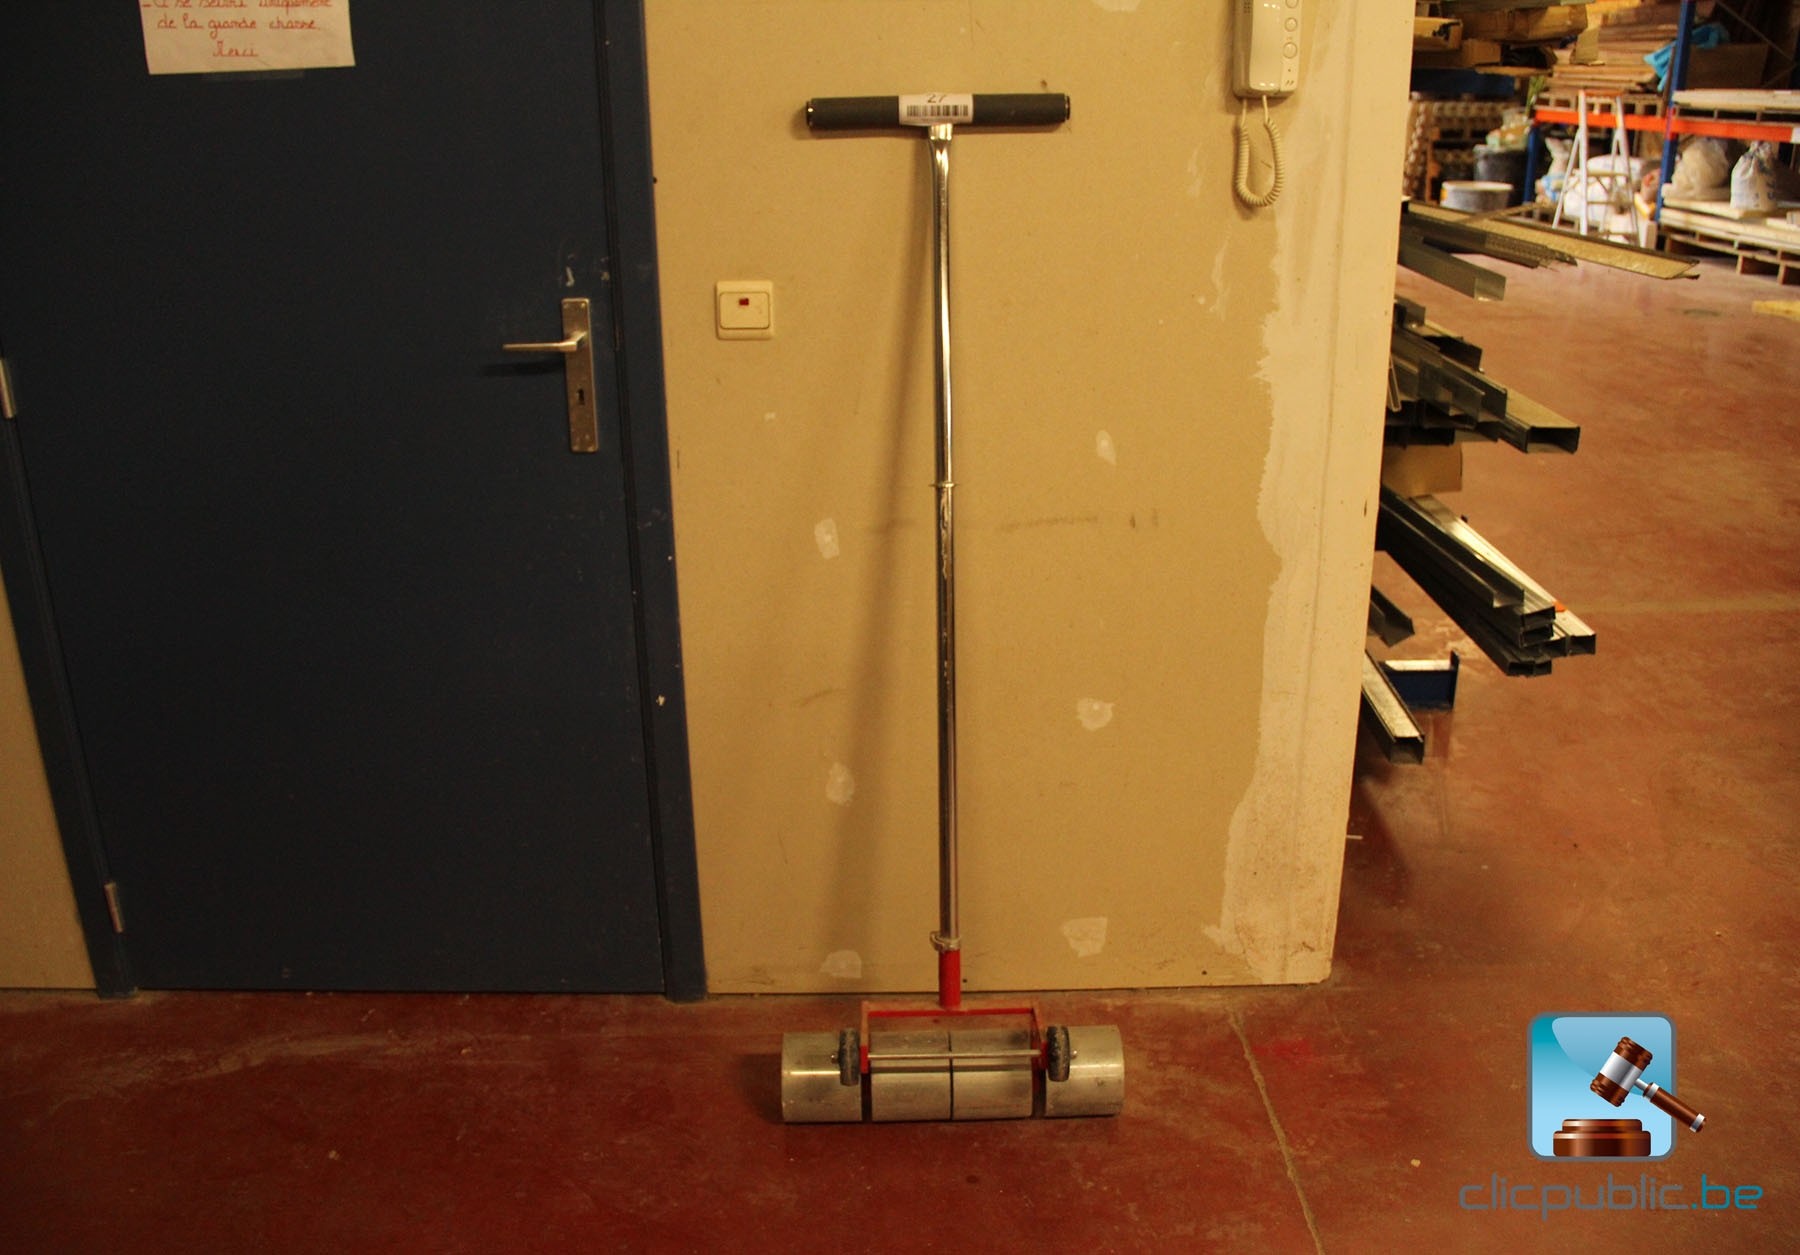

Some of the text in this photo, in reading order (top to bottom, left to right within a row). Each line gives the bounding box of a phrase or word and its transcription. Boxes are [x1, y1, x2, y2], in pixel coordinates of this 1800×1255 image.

[157, 13, 177, 29] de
[182, 13, 204, 29] la
[207, 16, 257, 39] grande
